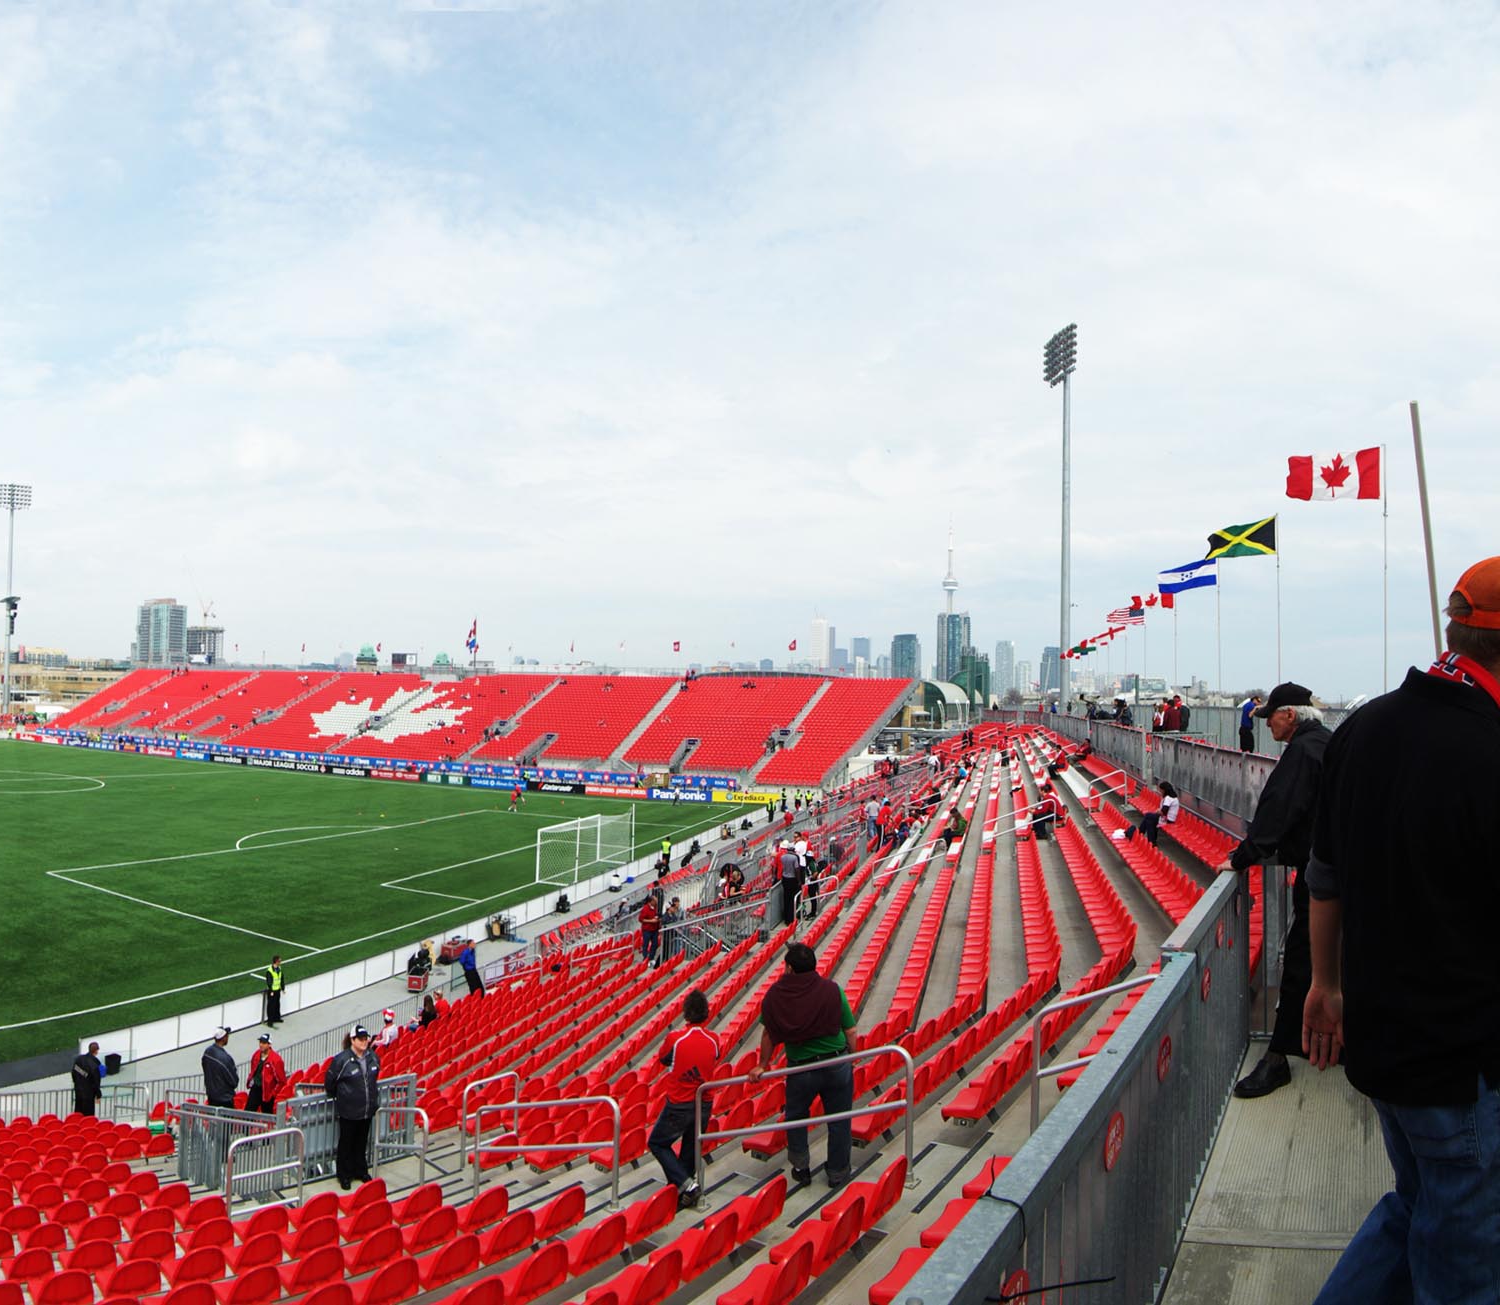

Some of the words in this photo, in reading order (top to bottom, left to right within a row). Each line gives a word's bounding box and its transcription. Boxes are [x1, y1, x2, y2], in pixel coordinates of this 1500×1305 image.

[253, 758, 273, 767] MAJOR
[273, 760, 295, 769] LEAGUE
[296, 763, 319, 772] SOCCER
[733, 794, 765, 803] Expedia.ca
